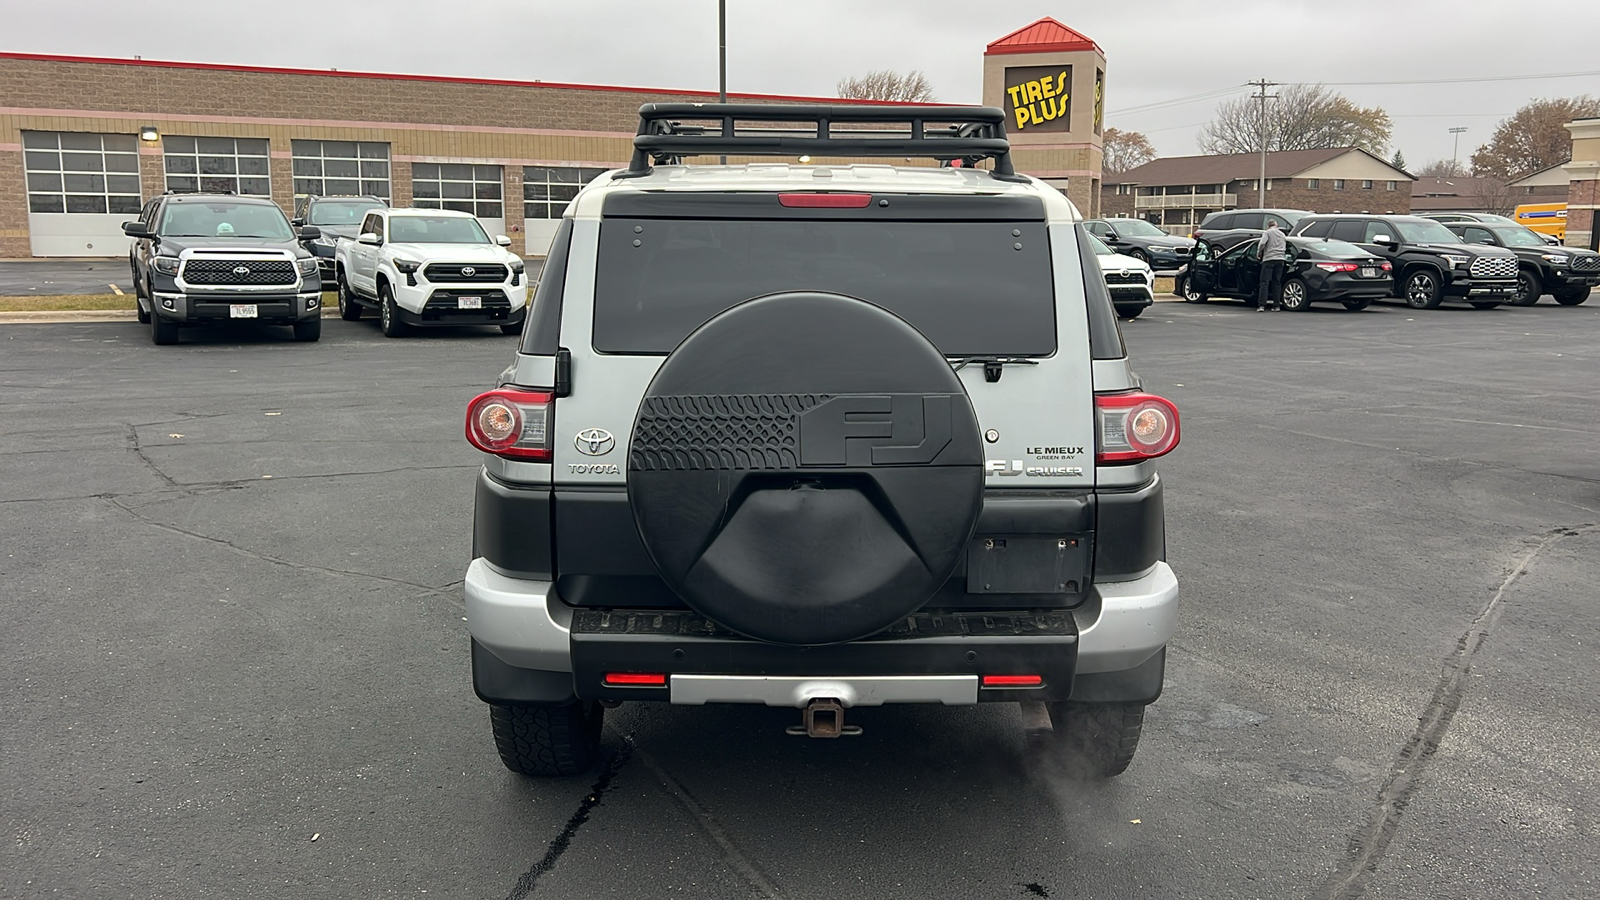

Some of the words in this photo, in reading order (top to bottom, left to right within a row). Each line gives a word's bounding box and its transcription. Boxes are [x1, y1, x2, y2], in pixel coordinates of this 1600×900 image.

[1007, 71, 1067, 108] TIRES
[1014, 93, 1069, 129] PLUS
[1026, 446, 1043, 454] LE
[1045, 446, 1084, 454] MIEUX
[568, 463, 620, 474] TOYOTA
[985, 459, 1023, 477] FJ
[1025, 466, 1083, 477] CRUISER
